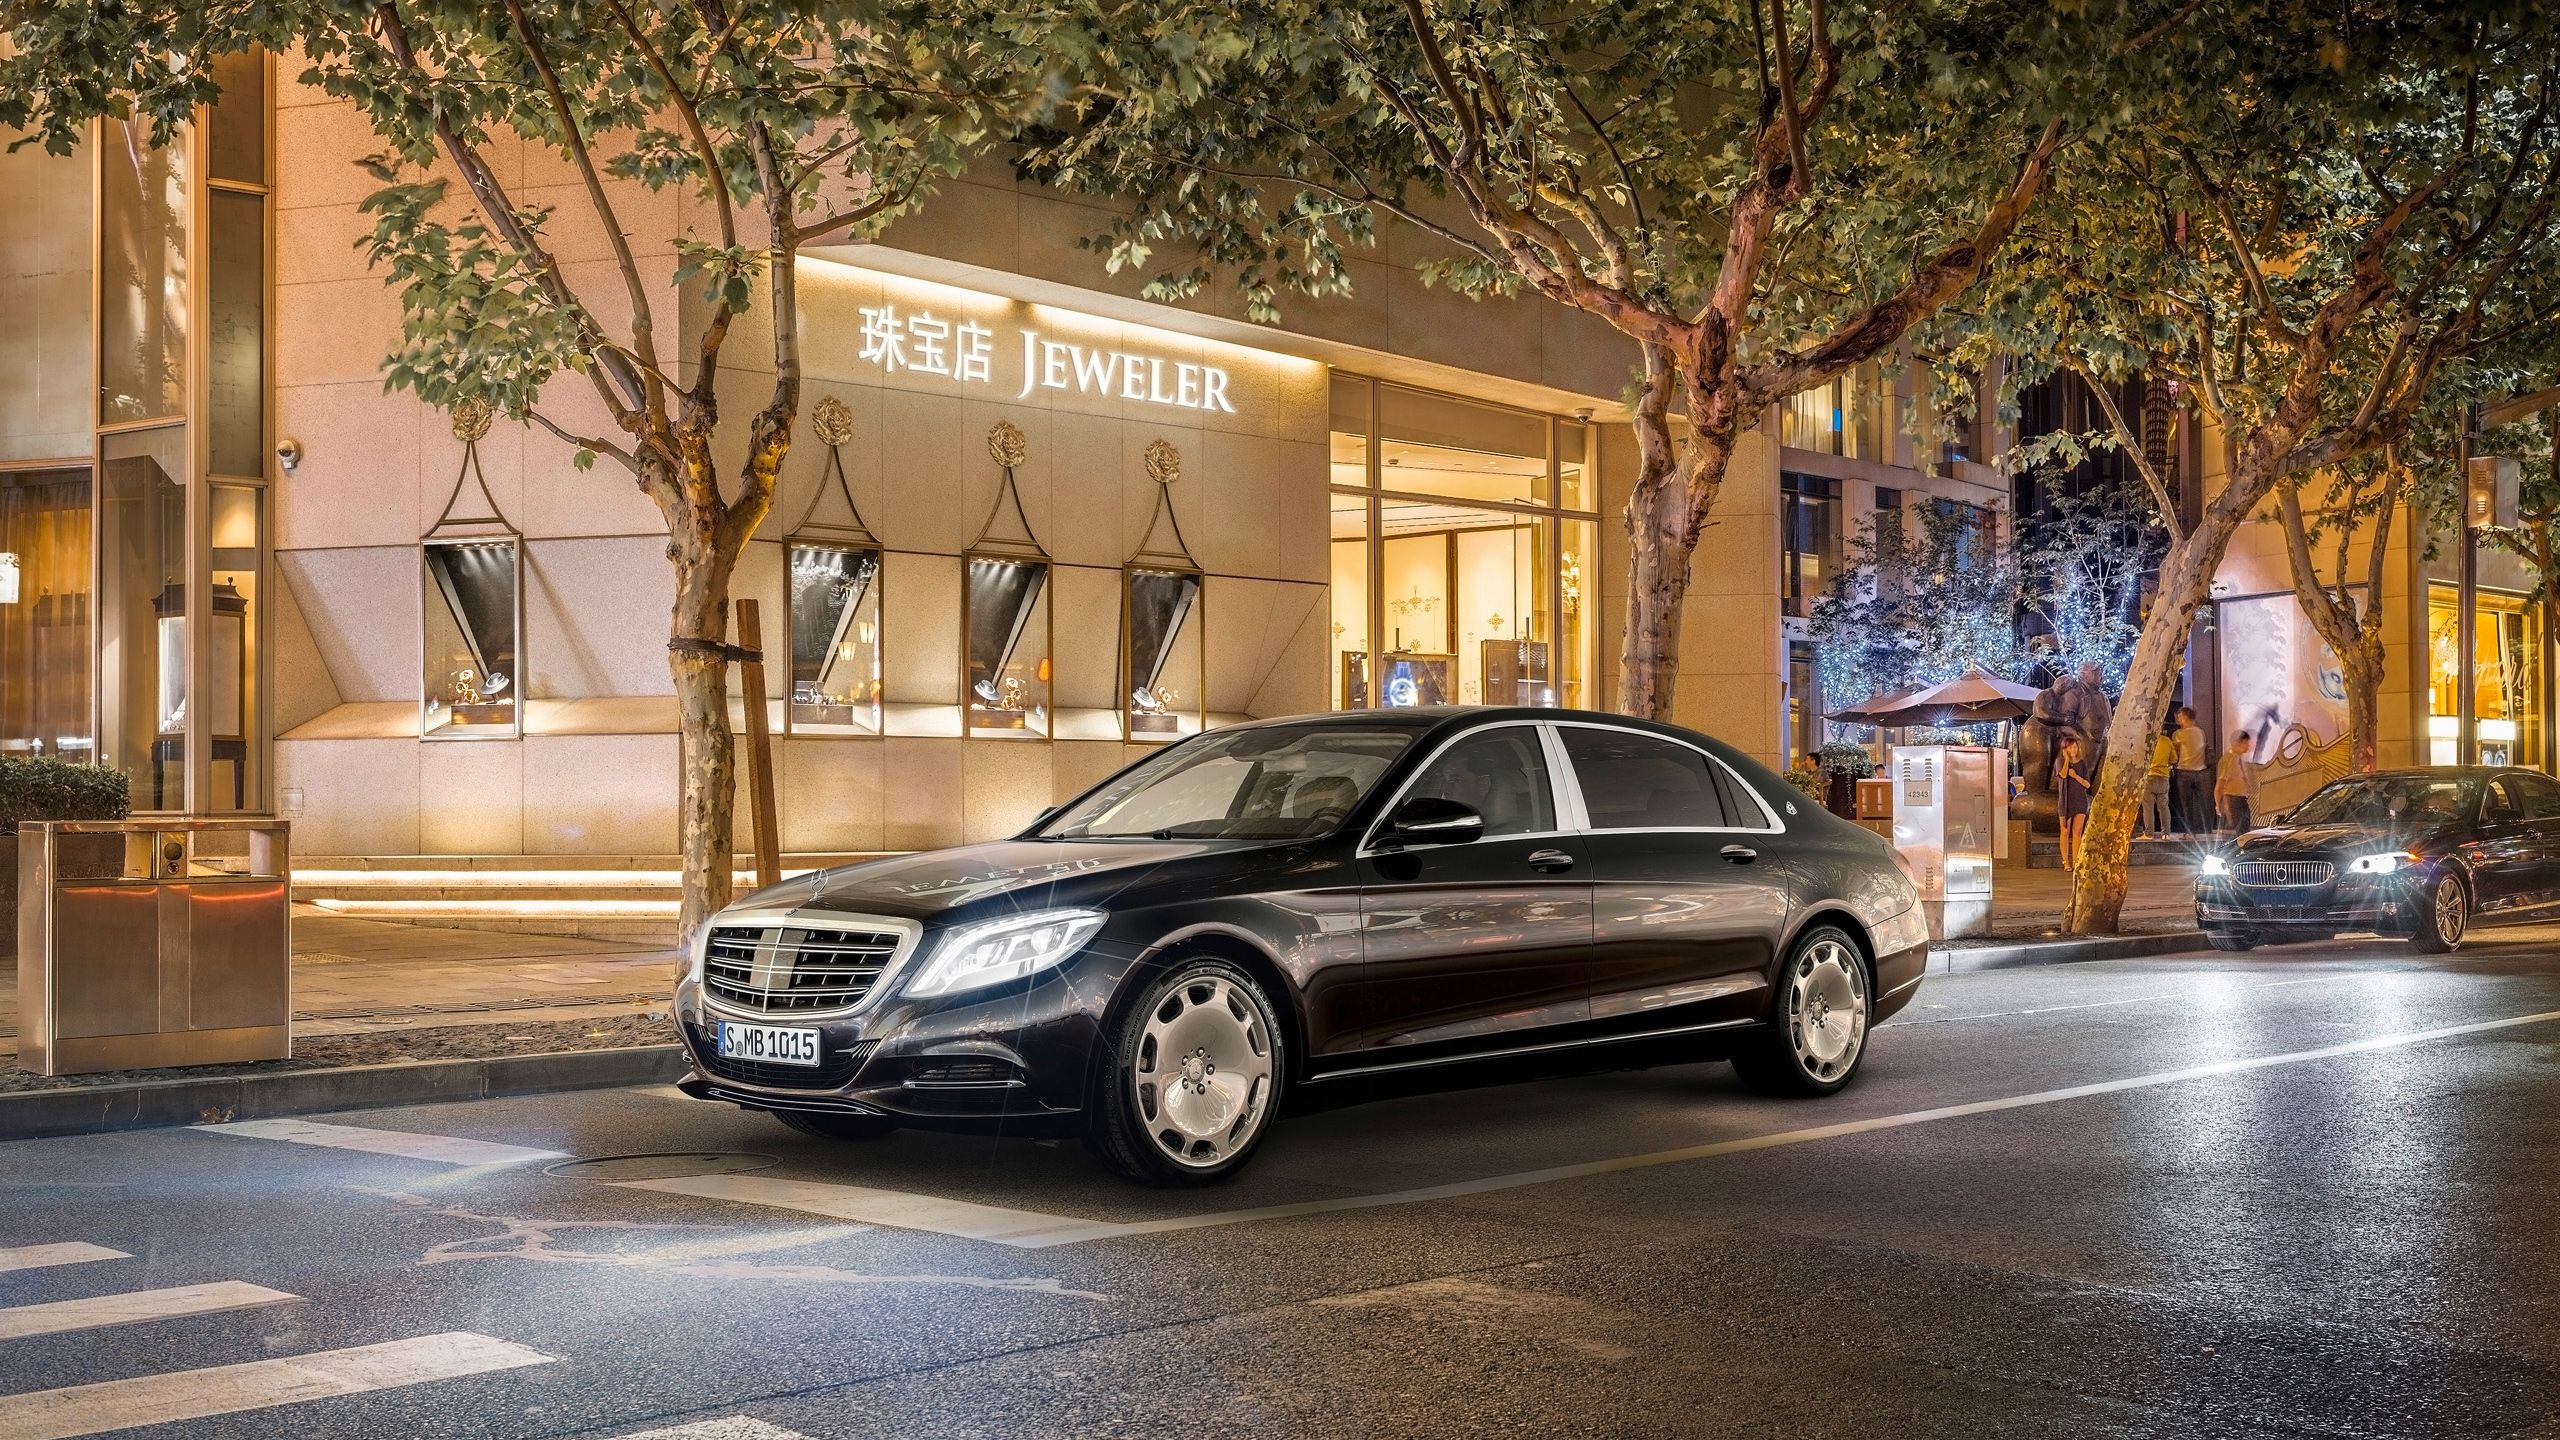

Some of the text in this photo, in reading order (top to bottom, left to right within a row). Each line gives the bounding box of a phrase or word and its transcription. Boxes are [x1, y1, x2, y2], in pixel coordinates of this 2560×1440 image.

[858, 305, 1236, 413] 珠宝店 JEWELER
[726, 1026, 814, 1060] S MB 1015
